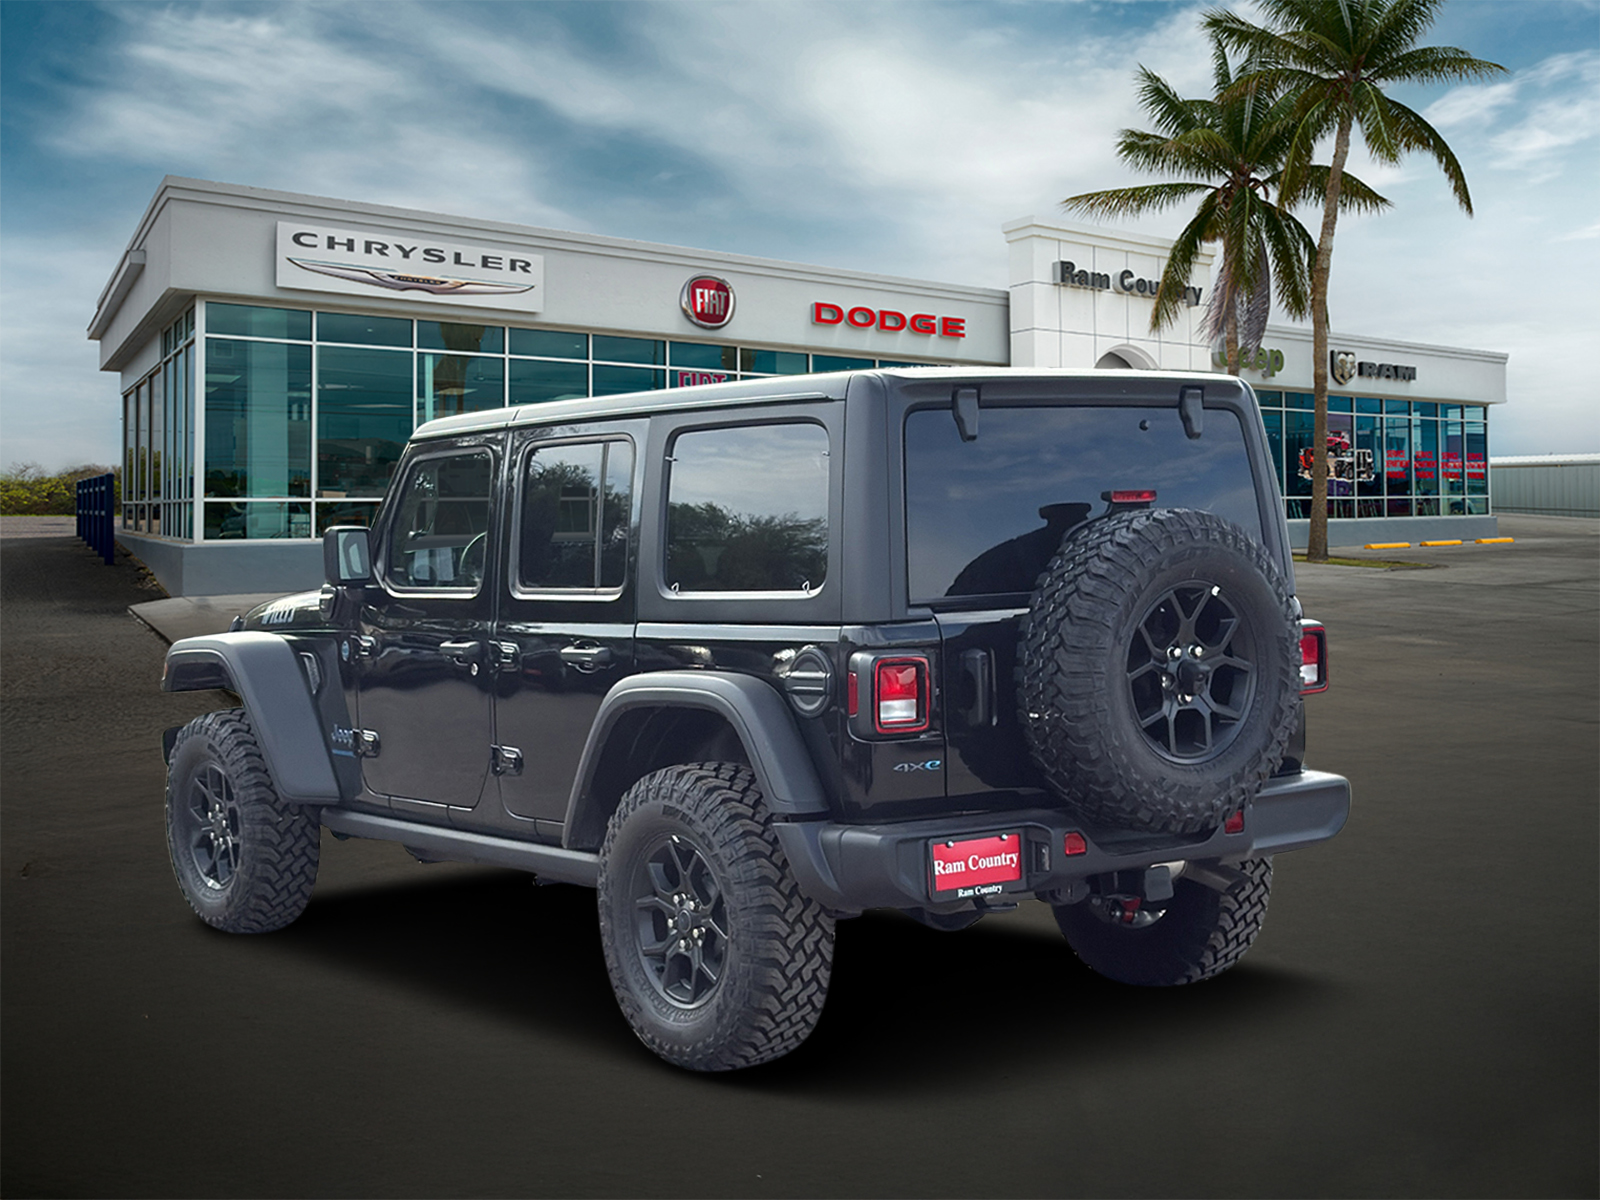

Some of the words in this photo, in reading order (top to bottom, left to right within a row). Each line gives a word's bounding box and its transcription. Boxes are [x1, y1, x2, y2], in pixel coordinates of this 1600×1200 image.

[292, 232, 532, 273] CHRYSLER
[1057, 260, 1110, 290] Ram
[1116, 269, 1203, 306] Coury
[695, 288, 728, 316] FIAT
[812, 301, 966, 338] DODGE
[1217, 345, 1284, 377] eep
[1358, 361, 1416, 381] RAM
[934, 859, 966, 876] Ram
[968, 852, 1019, 871] Country
[957, 888, 974, 898] Ram
[975, 884, 1002, 896] Country
